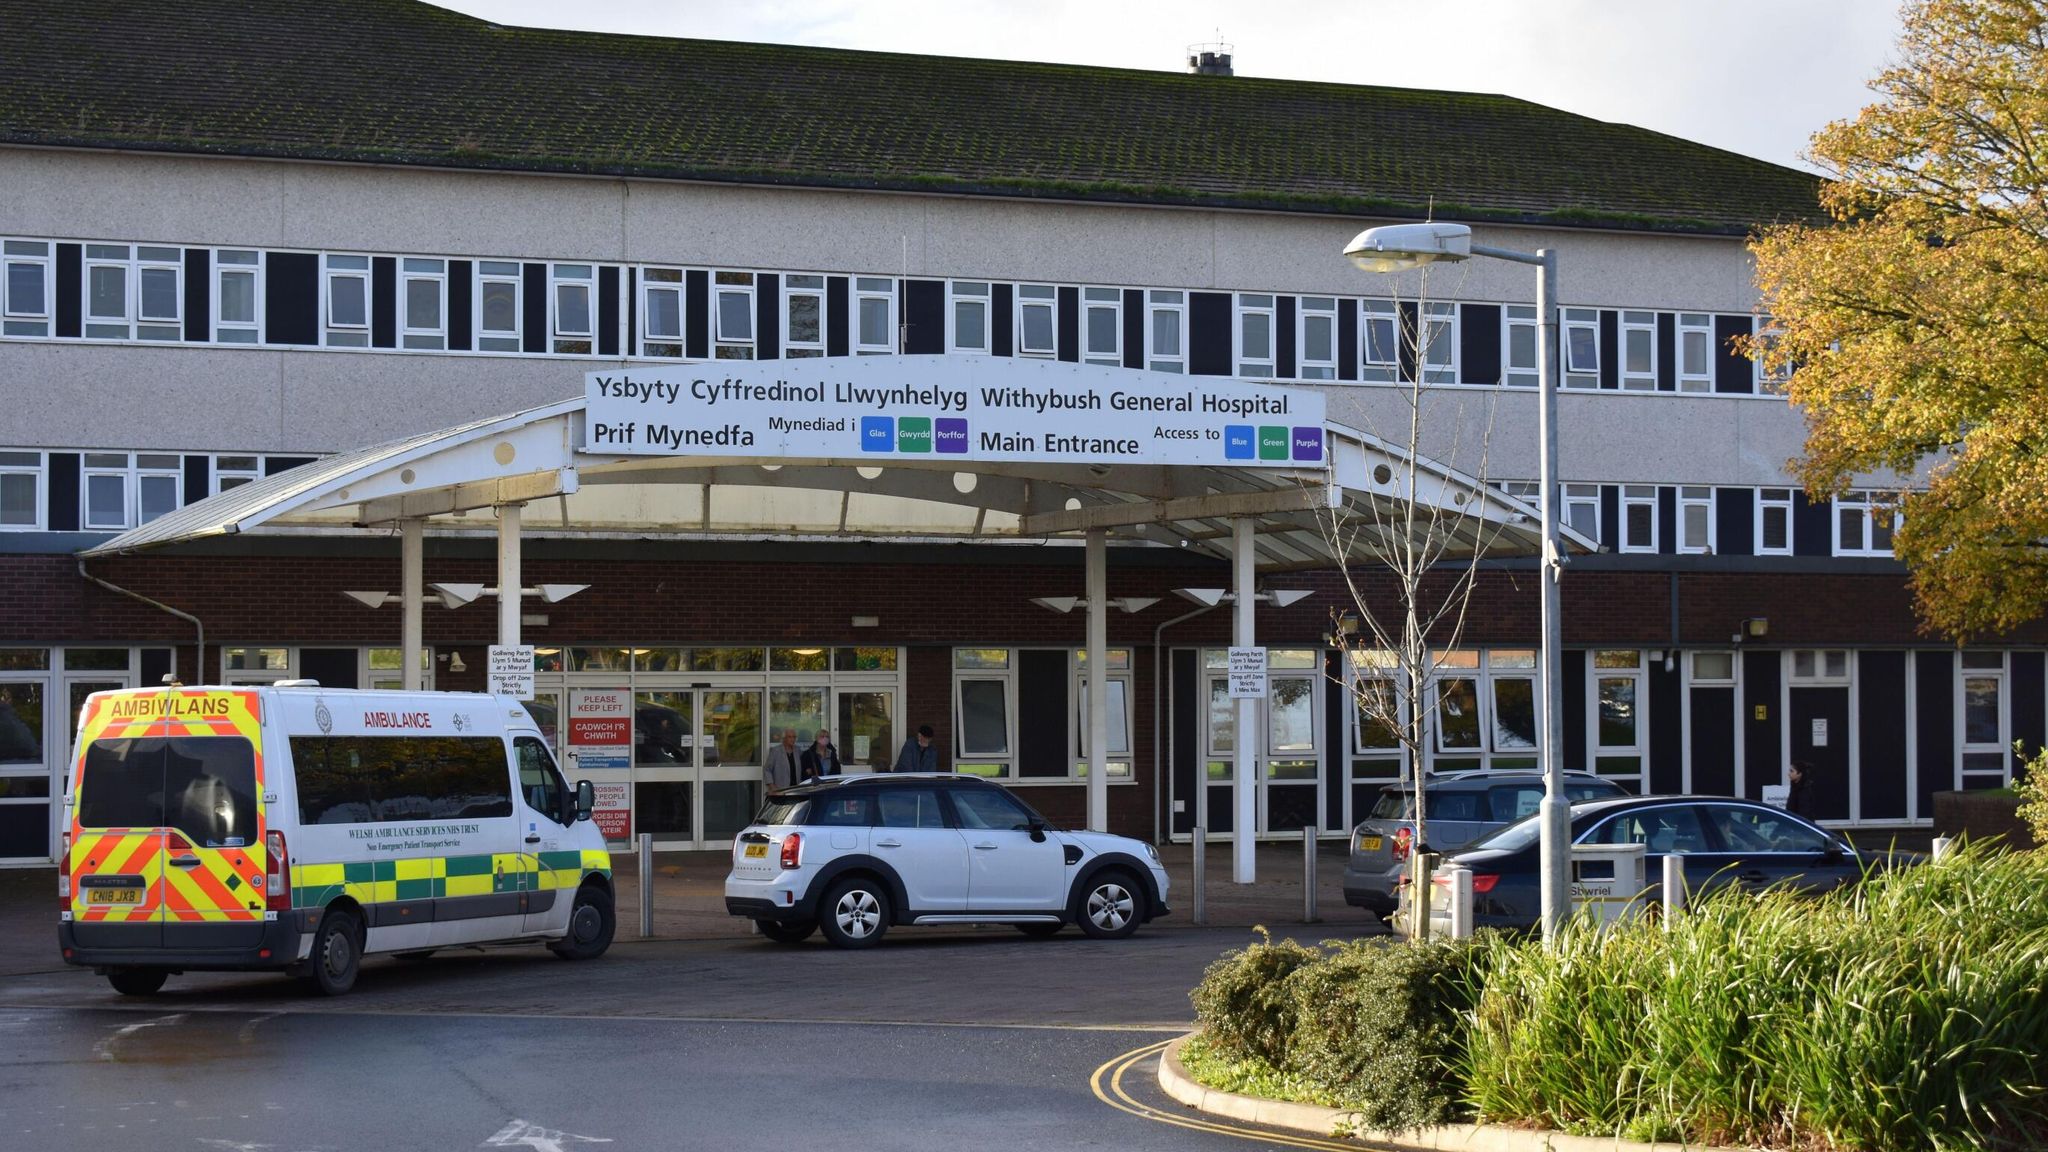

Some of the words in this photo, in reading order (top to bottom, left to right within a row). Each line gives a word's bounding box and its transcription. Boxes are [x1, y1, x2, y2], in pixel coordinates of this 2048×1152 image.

[595, 377, 680, 403] Ysbyty
[691, 379, 825, 405] Cyffredinol
[835, 382, 968, 411] Llwynhelyg
[981, 387, 1102, 413] Withybush
[1110, 391, 1193, 412] General
[1202, 394, 1288, 418] Hospital
[768, 416, 845, 435] Mynediad
[851, 418, 856, 432] i
[594, 423, 636, 444] Prif
[646, 424, 755, 450] Mynedfa
[869, 428, 887, 438] Glas
[899, 429, 931, 441] Gwyrdd
[937, 429, 966, 440] Porffor
[1153, 426, 1199, 440] Access
[1204, 428, 1221, 441] to
[980, 431, 1035, 452] Main
[1044, 433, 1140, 454] Entrance
[1231, 436, 1248, 446] Blue
[1262, 437, 1285, 447] Green
[1295, 438, 1319, 449] Purple
[584, 695, 617, 703] PLEASE
[111, 697, 230, 717] AMBIWLANS
[577, 704, 600, 712] KEEP
[602, 704, 623, 712] LEFT
[364, 711, 432, 729] AMBULANCE
[575, 723, 613, 731] CADWCH
[614, 723, 625, 731] I'R
[583, 731, 617, 740] CHWITH
[348, 829, 373, 840] WELSH
[374, 826, 415, 839] AMBULANCE
[415, 824, 446, 837] SERVICES
[446, 824, 460, 835] NHS
[460, 823, 480, 834] TRUST
[366, 842, 377, 851] Non
[378, 841, 404, 852] Emergency
[404, 840, 420, 849] Patient
[421, 839, 444, 850] Transport
[444, 838, 461, 847] Service
[1571, 886, 1611, 896] Sbwriel
